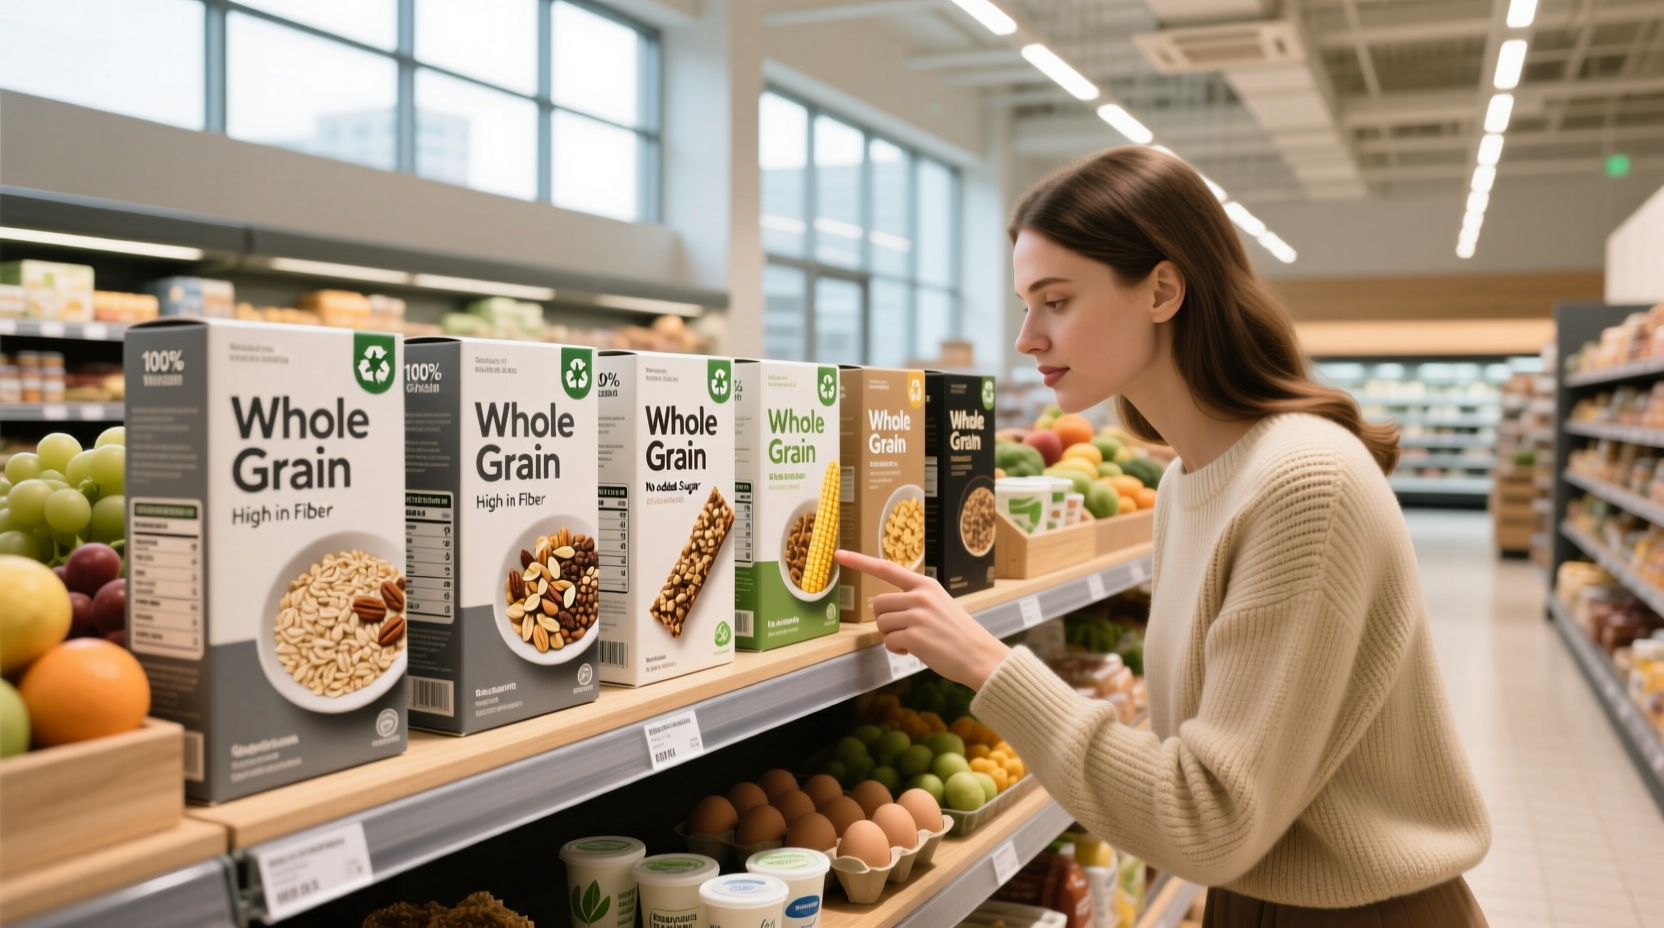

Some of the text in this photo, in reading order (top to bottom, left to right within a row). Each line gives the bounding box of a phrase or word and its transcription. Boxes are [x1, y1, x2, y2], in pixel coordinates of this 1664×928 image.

[142, 350, 184, 376] 100%
[404, 363, 441, 381] 100%
[231, 396, 369, 439] Whole
[475, 402, 574, 438] Whole
[645, 406, 717, 435] Whole
[768, 408, 824, 434] Whole
[869, 410, 910, 430] Whole
[646, 440, 706, 471] Grain
[769, 438, 815, 464] Grain
[869, 433, 906, 453] Grain
[232, 446, 350, 493] Grain
[476, 444, 560, 482] Grain
[233, 502, 333, 528] High in Fiber
[477, 492, 546, 512] High in Fiber
